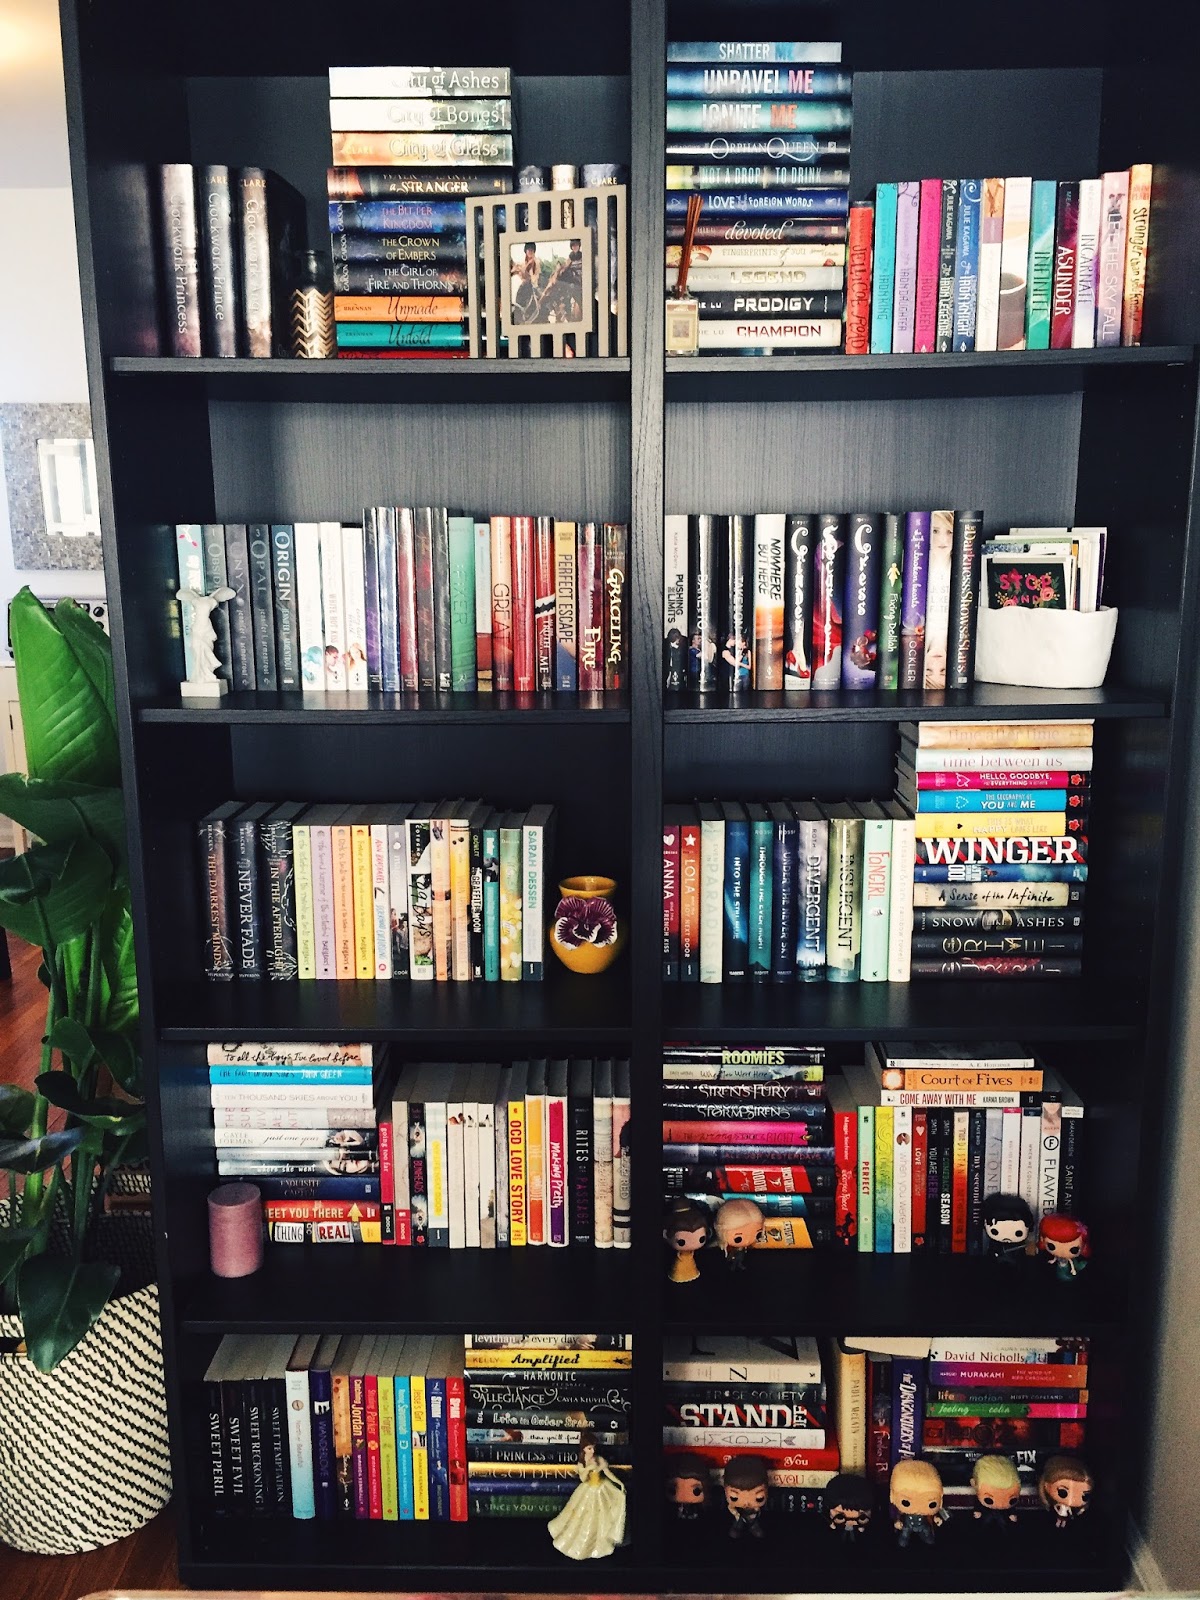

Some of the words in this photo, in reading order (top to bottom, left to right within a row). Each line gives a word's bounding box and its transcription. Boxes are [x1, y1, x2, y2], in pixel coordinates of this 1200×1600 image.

[720, 43, 770, 60] SHATTER
[449, 71, 499, 88] Ashes
[704, 70, 783, 94] UNRAVEL
[787, 70, 814, 94] ME
[447, 105, 498, 122] Bones
[703, 104, 762, 129] IGNITE
[770, 104, 798, 129] ME
[451, 139, 499, 157] Glass
[735, 167, 761, 184] DROP
[776, 167, 788, 184] TO
[792, 167, 822, 184] DRINK
[709, 195, 735, 209] LOVE
[208, 193, 223, 271] Clockwork
[725, 220, 794, 240] devoted
[1108, 214, 1120, 240] LET
[400, 236, 439, 247] CROWN
[400, 250, 437, 260] EMBERS
[400, 265, 423, 277] GIRL
[1078, 234, 1094, 304] INCARNATE
[1106, 244, 1119, 272] THE
[369, 277, 390, 292] FIRE
[413, 278, 452, 292] THORNS
[731, 271, 806, 284] LEGEND
[1032, 252, 1051, 315] INFINITE
[1055, 246, 1073, 316] ASUNDER
[1105, 277, 1117, 300] SKY
[176, 276, 189, 334] Princess
[213, 276, 225, 320] Prince
[387, 296, 439, 322] Unmade
[734, 297, 814, 312] PRODIGY
[737, 326, 821, 338] CHAMPION
[1102, 307, 1115, 340] FALL
[275, 532, 291, 600] ORIGIN
[758, 544, 769, 563] BUT
[251, 540, 267, 596] OPAL
[558, 554, 573, 599] PERFECT
[758, 567, 769, 595] HERE
[769, 538, 781, 600] NOWHERE
[675, 574, 683, 616] PUSHING
[884, 593, 898, 620] Fixing
[494, 583, 510, 641] GREAT
[559, 604, 573, 642] ESCAPE
[607, 568, 624, 664] GRACELING
[581, 626, 601, 671] FIRE
[887, 623, 897, 652] Delilah
[907, 641, 916, 682] OCKLER
[944, 757, 975, 768] time
[980, 755, 1040, 767] between
[1046, 757, 1062, 767] us
[981, 801, 1004, 810] YOU
[1021, 800, 1036, 809] ME
[528, 831, 537, 867] SARAH
[922, 836, 1078, 864] WINGER
[207, 854, 216, 876] THE
[270, 867, 279, 878] IN
[684, 860, 695, 894] LOLA
[271, 881, 280, 903] THE
[528, 872, 537, 909] DESSEN
[663, 859, 674, 899] ANNA
[209, 880, 219, 929] DARKEST
[238, 870, 251, 924] NEVER
[805, 854, 821, 952] DIVERGENT
[838, 854, 855, 951] INSURGENT
[950, 888, 978, 901] Sense
[1008, 887, 1055, 904] Infinite
[932, 918, 977, 927] SNOW
[1016, 918, 1064, 927] ASHES
[212, 932, 221, 966] MINDS
[240, 928, 254, 969] FADE
[722, 1050, 785, 1065] ROOMIES
[921, 1073, 960, 1086] Court
[976, 1073, 1013, 1086] Fives
[900, 1093, 919, 1104] COME
[922, 1093, 943, 1104] AWAY
[945, 1093, 964, 1104] WITH
[966, 1093, 976, 1104] ME
[511, 1120, 522, 1144] OCD
[575, 1130, 589, 1162] RITES
[929, 1147, 937, 1160] YOU
[511, 1150, 522, 1180] LOVE
[929, 1161, 937, 1174] ARE
[1065, 1165, 1074, 1189] SAINT
[1042, 1158, 1056, 1216] FLAWED
[266, 1208, 289, 1218] EET
[290, 1208, 309, 1218] YOU
[312, 1207, 344, 1218] THERE
[512, 1185, 523, 1224] STORY
[940, 1193, 950, 1225] SEASON
[276, 1225, 303, 1240] THING
[319, 1225, 350, 1240] REAL
[511, 1354, 580, 1367] Amplified
[945, 1351, 975, 1362] David
[980, 1352, 1024, 1363] Nicholls
[524, 1371, 577, 1381] HARMONIC
[479, 1392, 545, 1403] ALLEGIANCE
[250, 1407, 260, 1439] SWEET
[352, 1404, 365, 1436] Jordan
[680, 1403, 793, 1428] STAND
[209, 1412, 222, 1456] SWEET
[229, 1417, 241, 1462] SWEET
[1016, 1450, 1036, 1463] FIX
[213, 1460, 224, 1497] PERIL
[232, 1466, 244, 1496] EVIL
